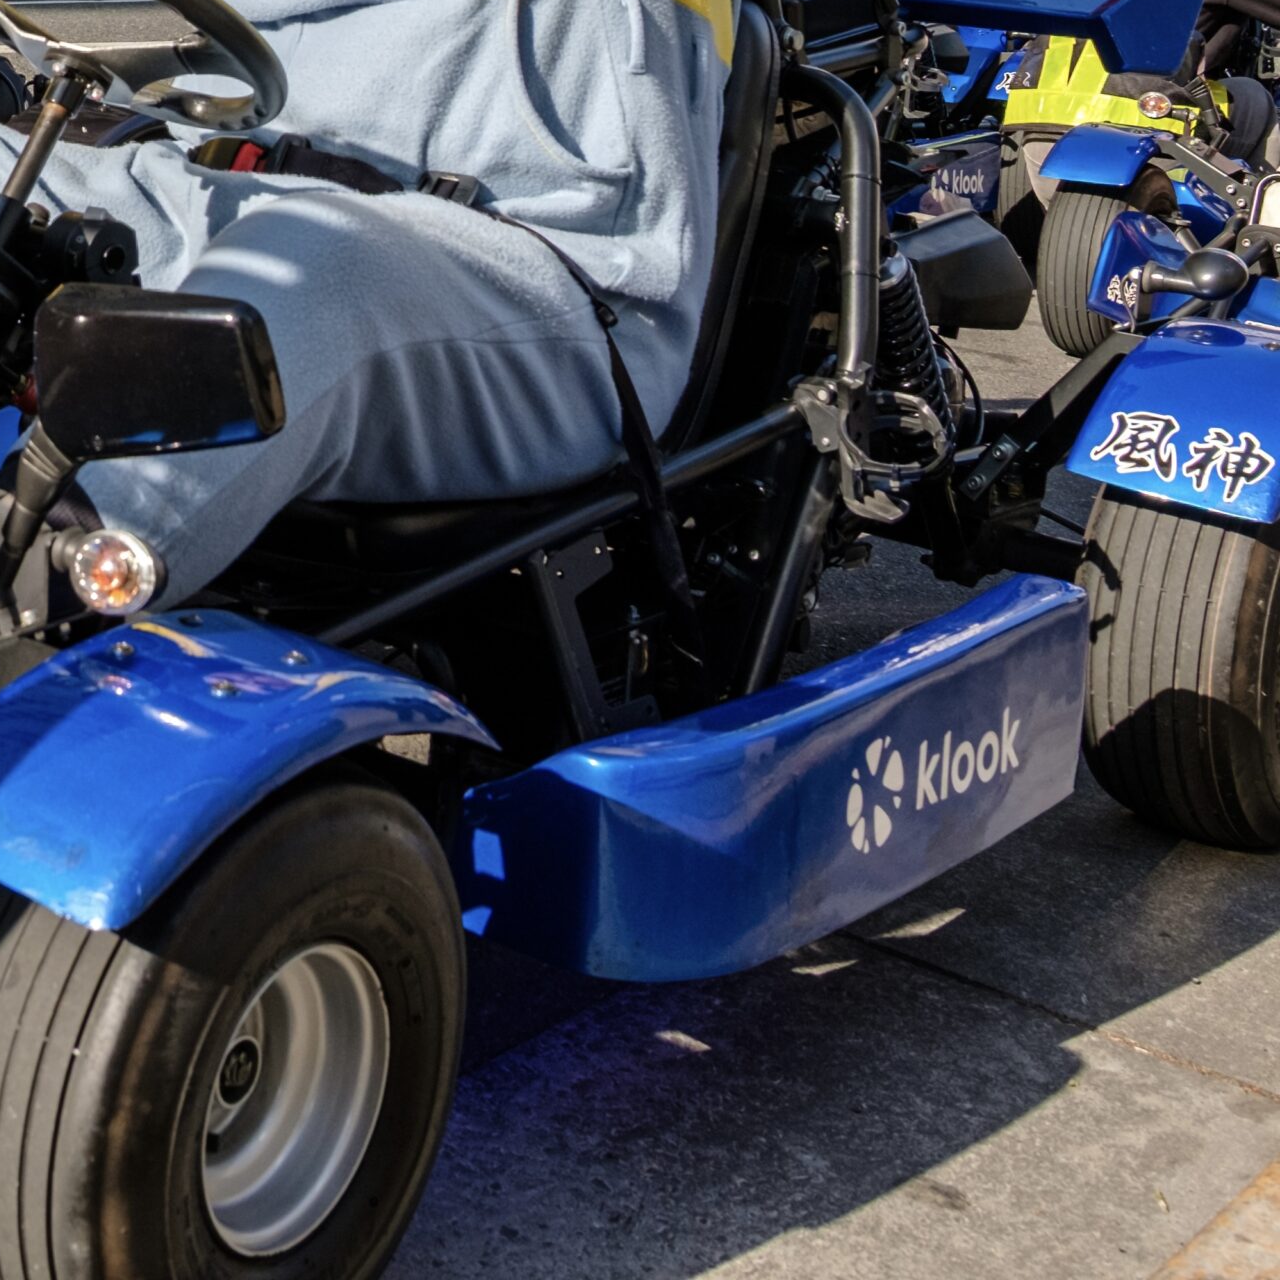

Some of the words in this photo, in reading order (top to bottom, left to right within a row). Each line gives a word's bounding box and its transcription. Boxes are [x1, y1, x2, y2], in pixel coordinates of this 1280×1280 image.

[952, 168, 985, 194] klook
[1089, 410, 1276, 503] 風神
[915, 706, 1020, 811] klook
